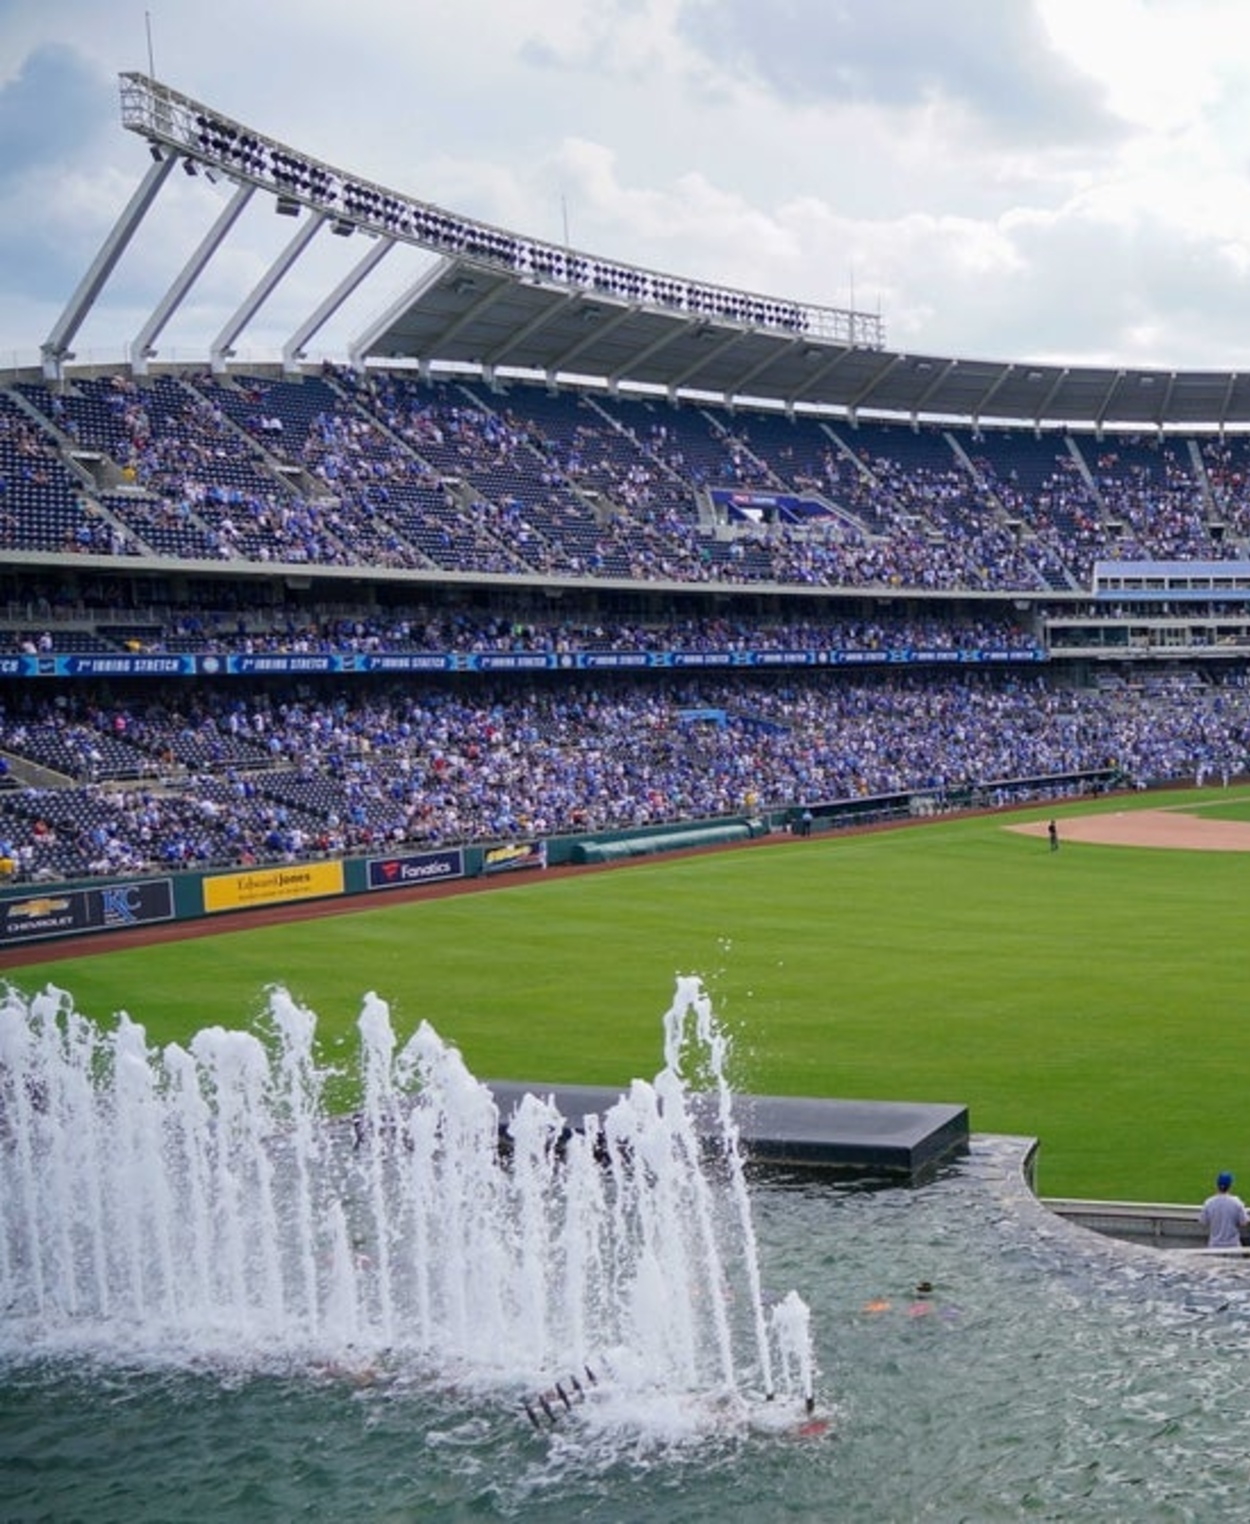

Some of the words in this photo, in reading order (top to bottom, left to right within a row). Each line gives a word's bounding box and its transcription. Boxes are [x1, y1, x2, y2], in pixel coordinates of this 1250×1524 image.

[401, 861, 451, 879] Fanatics
[101, 886, 142, 924] KC
[7, 916, 73, 932] CHEVROLET
